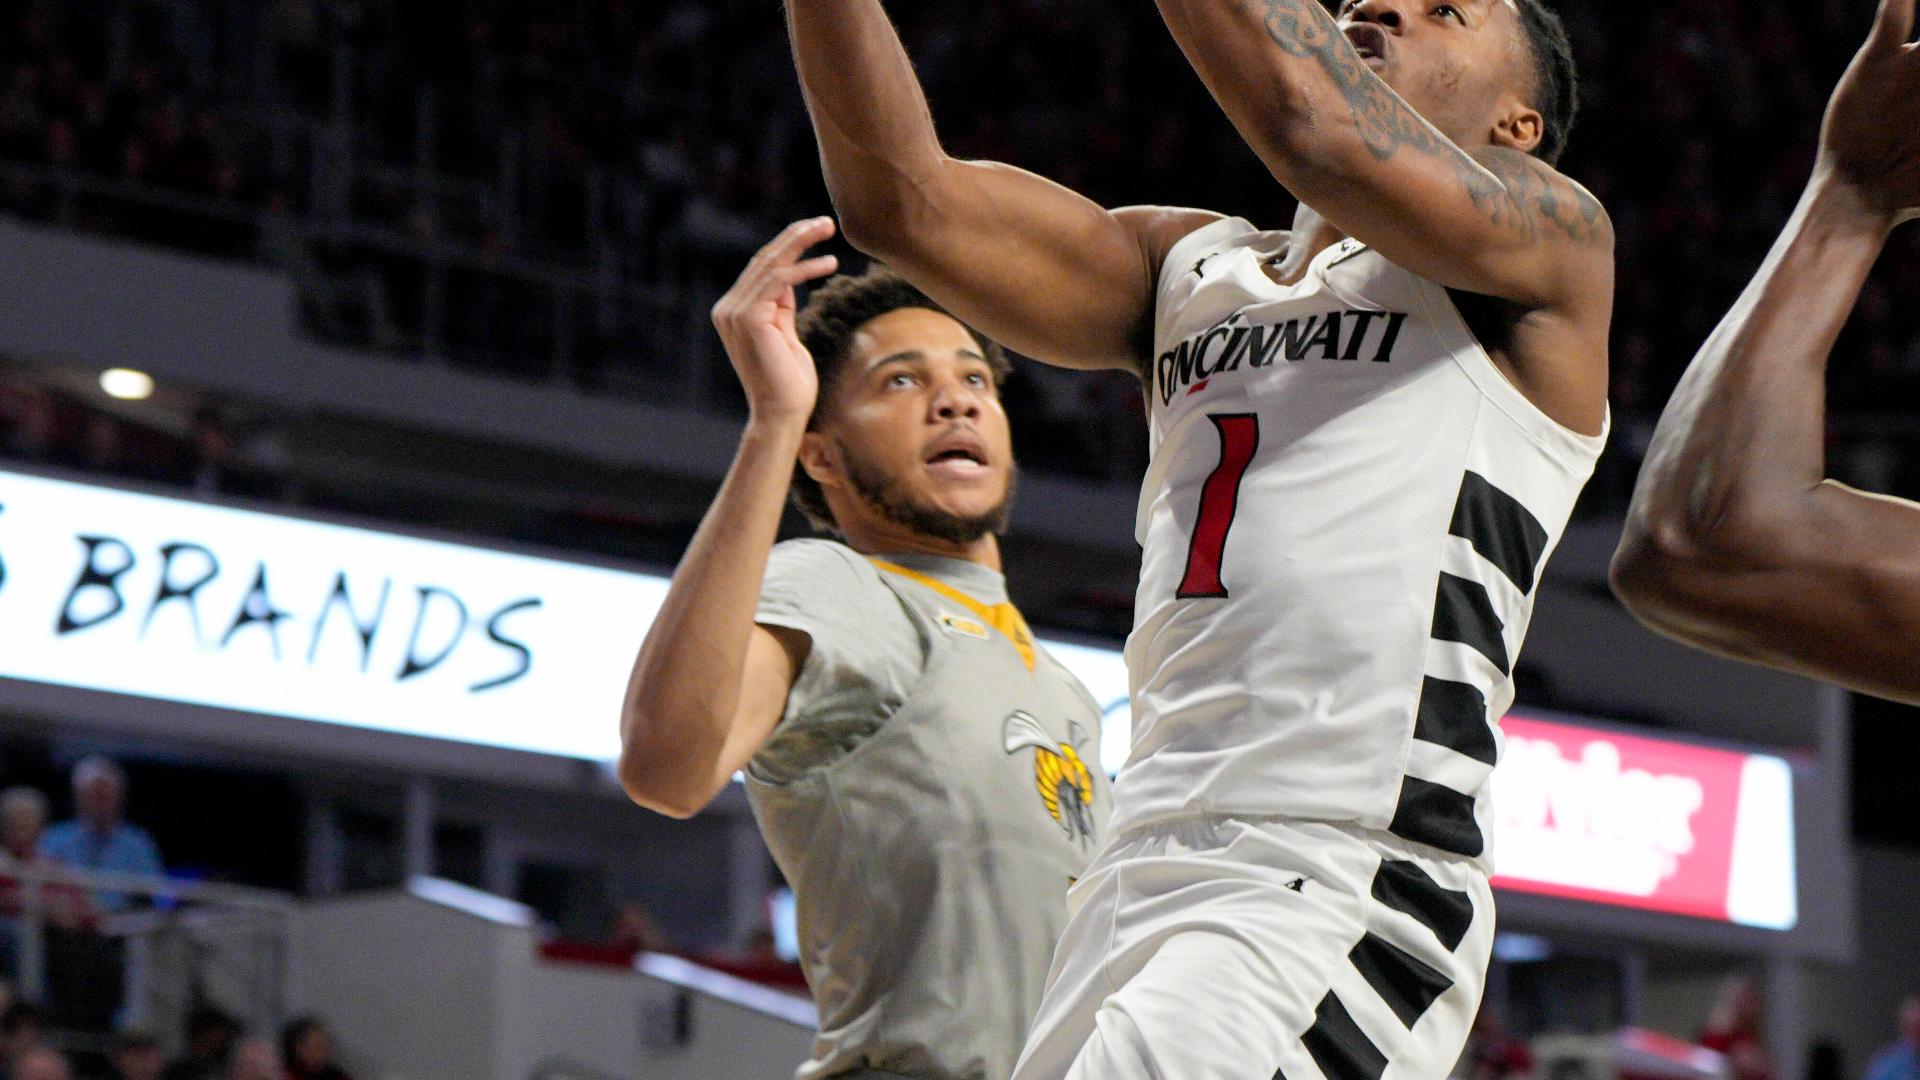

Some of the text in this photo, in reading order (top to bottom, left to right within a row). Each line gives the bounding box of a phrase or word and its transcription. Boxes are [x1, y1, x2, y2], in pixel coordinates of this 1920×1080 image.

[1158, 310, 1408, 407] CINCINNATI
[1176, 413, 1259, 600] 1
[54, 534, 543, 693] BRANDS
